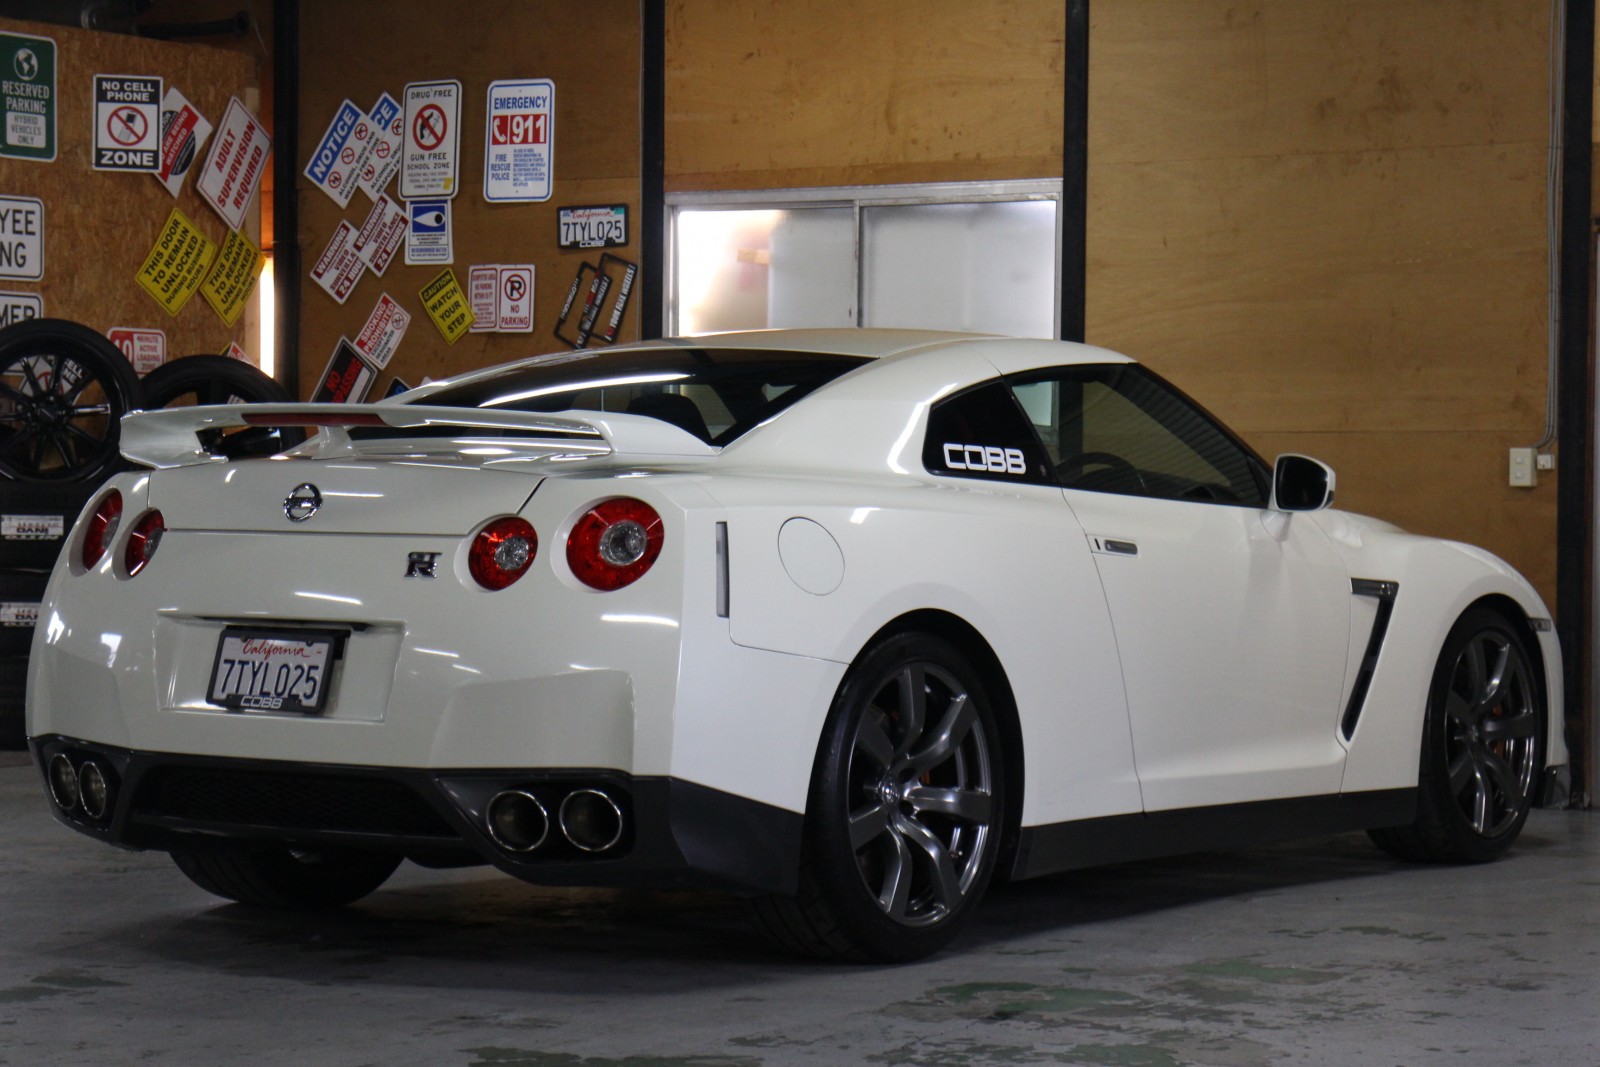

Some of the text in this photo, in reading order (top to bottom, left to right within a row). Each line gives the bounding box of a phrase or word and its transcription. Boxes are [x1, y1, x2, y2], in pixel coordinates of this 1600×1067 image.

[2, 81, 50, 99] RESERVED
[102, 81, 155, 92] NO CELL
[107, 91, 149, 102] PHONE
[411, 89, 452, 99] DRUG FREE
[6, 97, 46, 114] PARKING
[494, 96, 548, 110] EMERGENCY
[11, 125, 42, 136] VEHICLES
[14, 115, 38, 125] HYBRID
[172, 110, 189, 136] BEING
[512, 115, 545, 143] 911
[18, 136, 34, 145] ONLY
[166, 128, 188, 166] WATCHED
[215, 128, 236, 173] ADULT
[313, 109, 355, 179] NOTICE
[101, 150, 154, 166] ZONE
[217, 120, 256, 207] SUPERVISION
[406, 163, 431, 171] SCHOOL
[410, 152, 447, 162] GUN FREE
[491, 163, 511, 171] RESCUE
[495, 154, 507, 162] FIRE
[233, 145, 263, 210] REQUIRED
[491, 172, 510, 181] POLICE
[356, 200, 386, 248] WARNING
[562, 220, 622, 242] 7TYL025
[144, 218, 181, 276] THIS DOOR
[152, 226, 190, 285] TO REMAIN
[316, 227, 347, 274] WARNING
[377, 252, 388, 267] 24
[161, 235, 198, 294] UNLOCKED
[165, 239, 207, 305] DURING BUSINESS
[209, 263, 226, 288] THIS
[214, 239, 246, 297] TO REMAIN
[220, 248, 252, 305] UNLOCKED
[329, 253, 355, 291] SURVEILLA
[338, 280, 350, 295] 24
[348, 259, 363, 281] HOU
[186, 264, 205, 291] HOURS
[423, 273, 451, 299] CAUTION
[430, 286, 458, 313] WATCH
[439, 300, 462, 322] YOUR
[510, 304, 520, 313] NO
[361, 303, 386, 342] SMOKING
[363, 302, 394, 353] PROHIBITED
[447, 313, 466, 333] STEP
[501, 316, 528, 326] PARKING
[325, 370, 341, 393] NO
[943, 443, 1026, 475] COBB
[242, 639, 311, 661] California
[221, 659, 320, 700] 7TYL025
[240, 695, 283, 709] COBB
